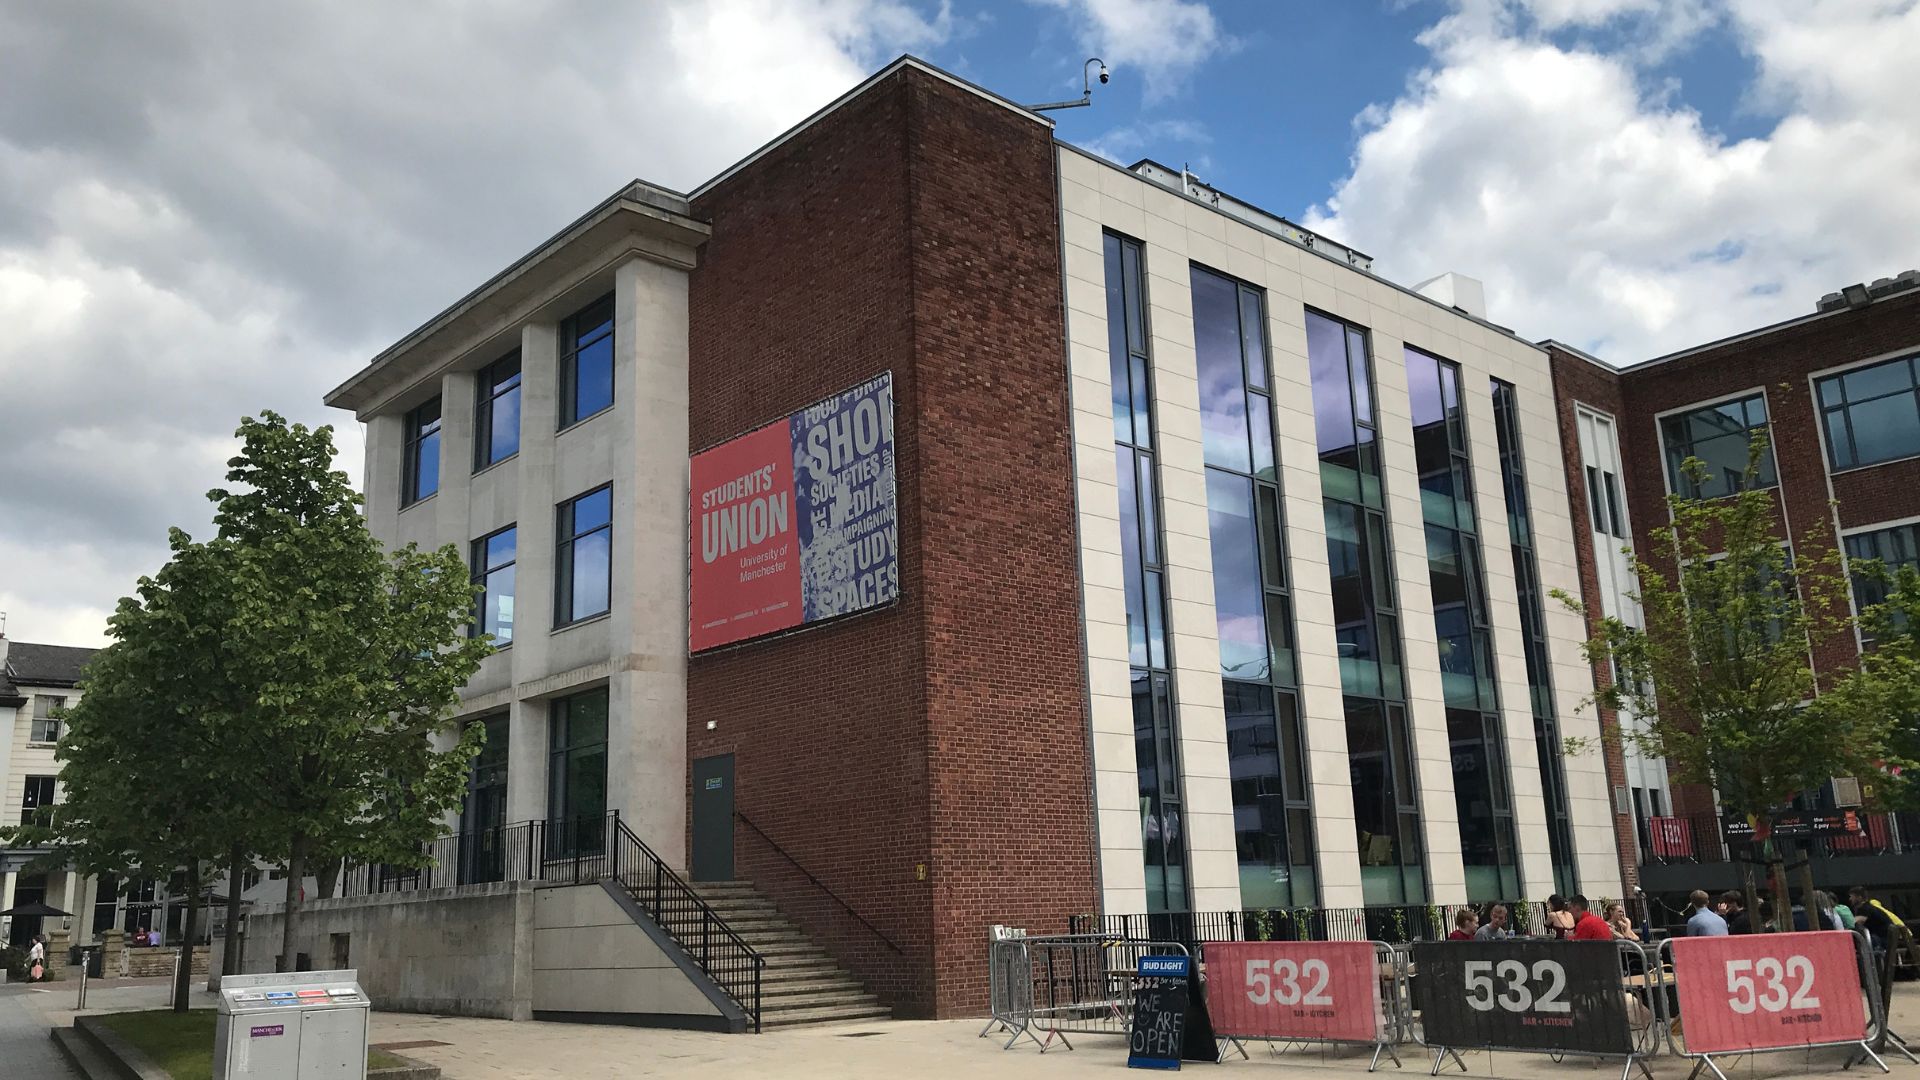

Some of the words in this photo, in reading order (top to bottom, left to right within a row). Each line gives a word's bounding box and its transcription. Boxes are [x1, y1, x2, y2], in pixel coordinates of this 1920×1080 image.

[702, 463, 776, 510] STUDENTS'
[811, 453, 880, 507] SOCIETIES
[702, 491, 788, 564] UNION
[838, 505, 896, 541] MPAIGNING
[740, 548, 779, 569] University
[780, 544, 788, 556] of
[832, 525, 897, 581] STUDY
[740, 561, 787, 583] Manchester
[1143, 961, 1160, 970] BUD
[1160, 961, 1184, 970] LIGHT
[1137, 976, 1160, 990] 532
[1246, 958, 1333, 1006] 532
[1464, 959, 1571, 1012] 532
[1726, 955, 1820, 1014] 532
[1138, 993, 1160, 1012] WE
[1155, 1011, 1183, 1032] ARE
[1523, 1017, 1537, 1026] BAR
[1543, 1017, 1573, 1027] KITCHEN
[1132, 1028, 1179, 1056] OPEN
